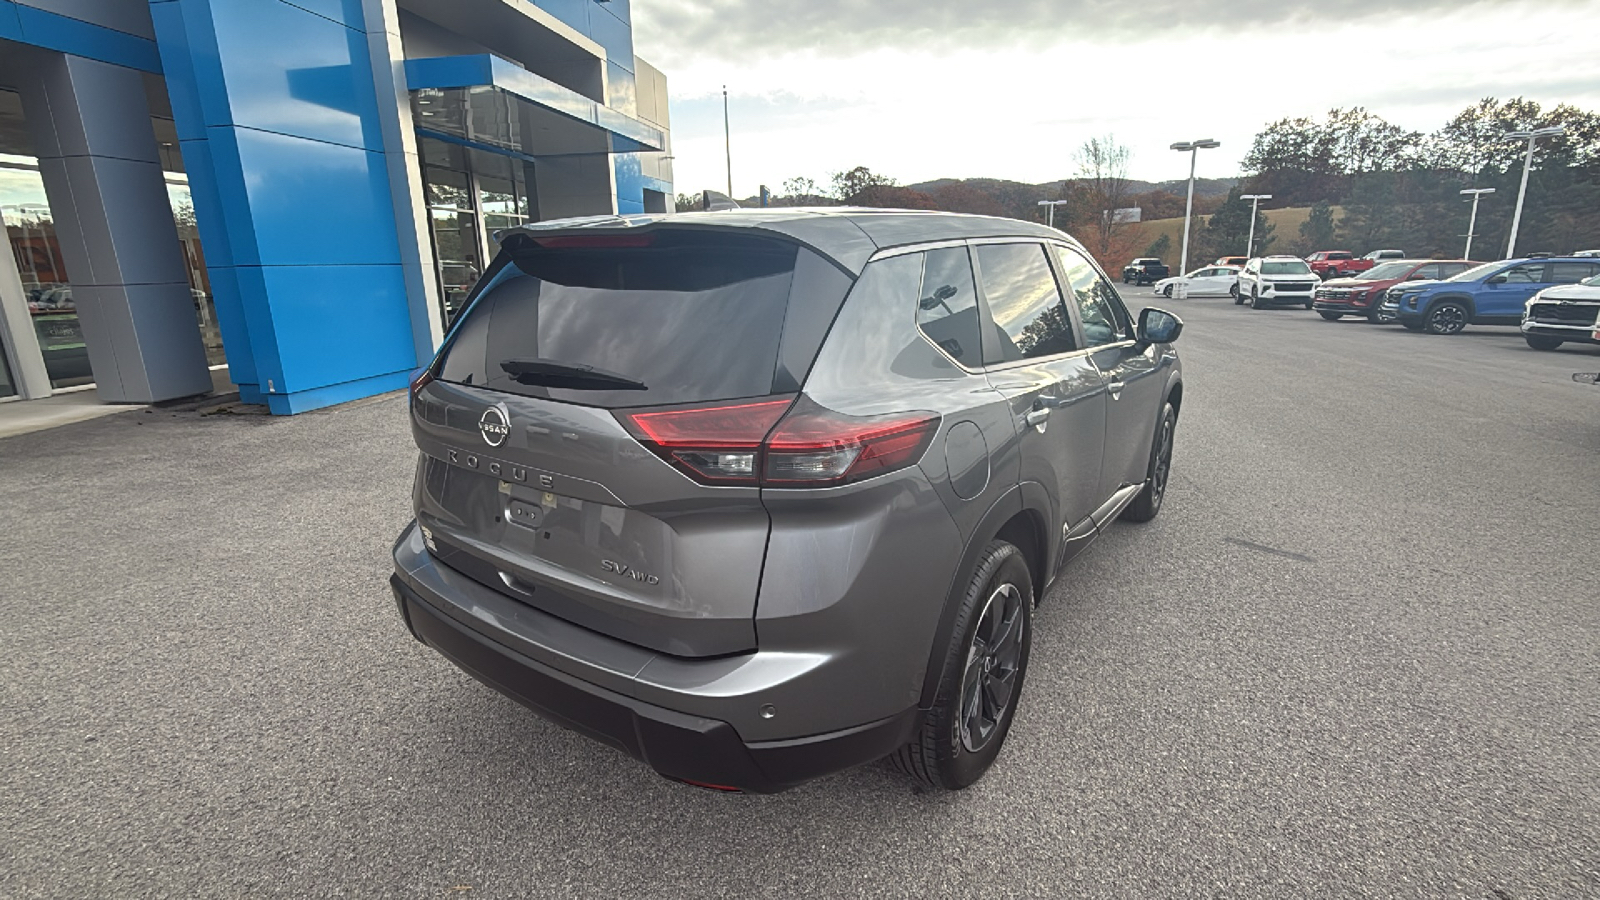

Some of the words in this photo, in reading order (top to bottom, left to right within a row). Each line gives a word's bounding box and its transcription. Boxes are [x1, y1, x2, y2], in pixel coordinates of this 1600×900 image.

[447, 449, 554, 489] ROGUE
[601, 559, 629, 576] SV
[627, 569, 659, 586] AWD
